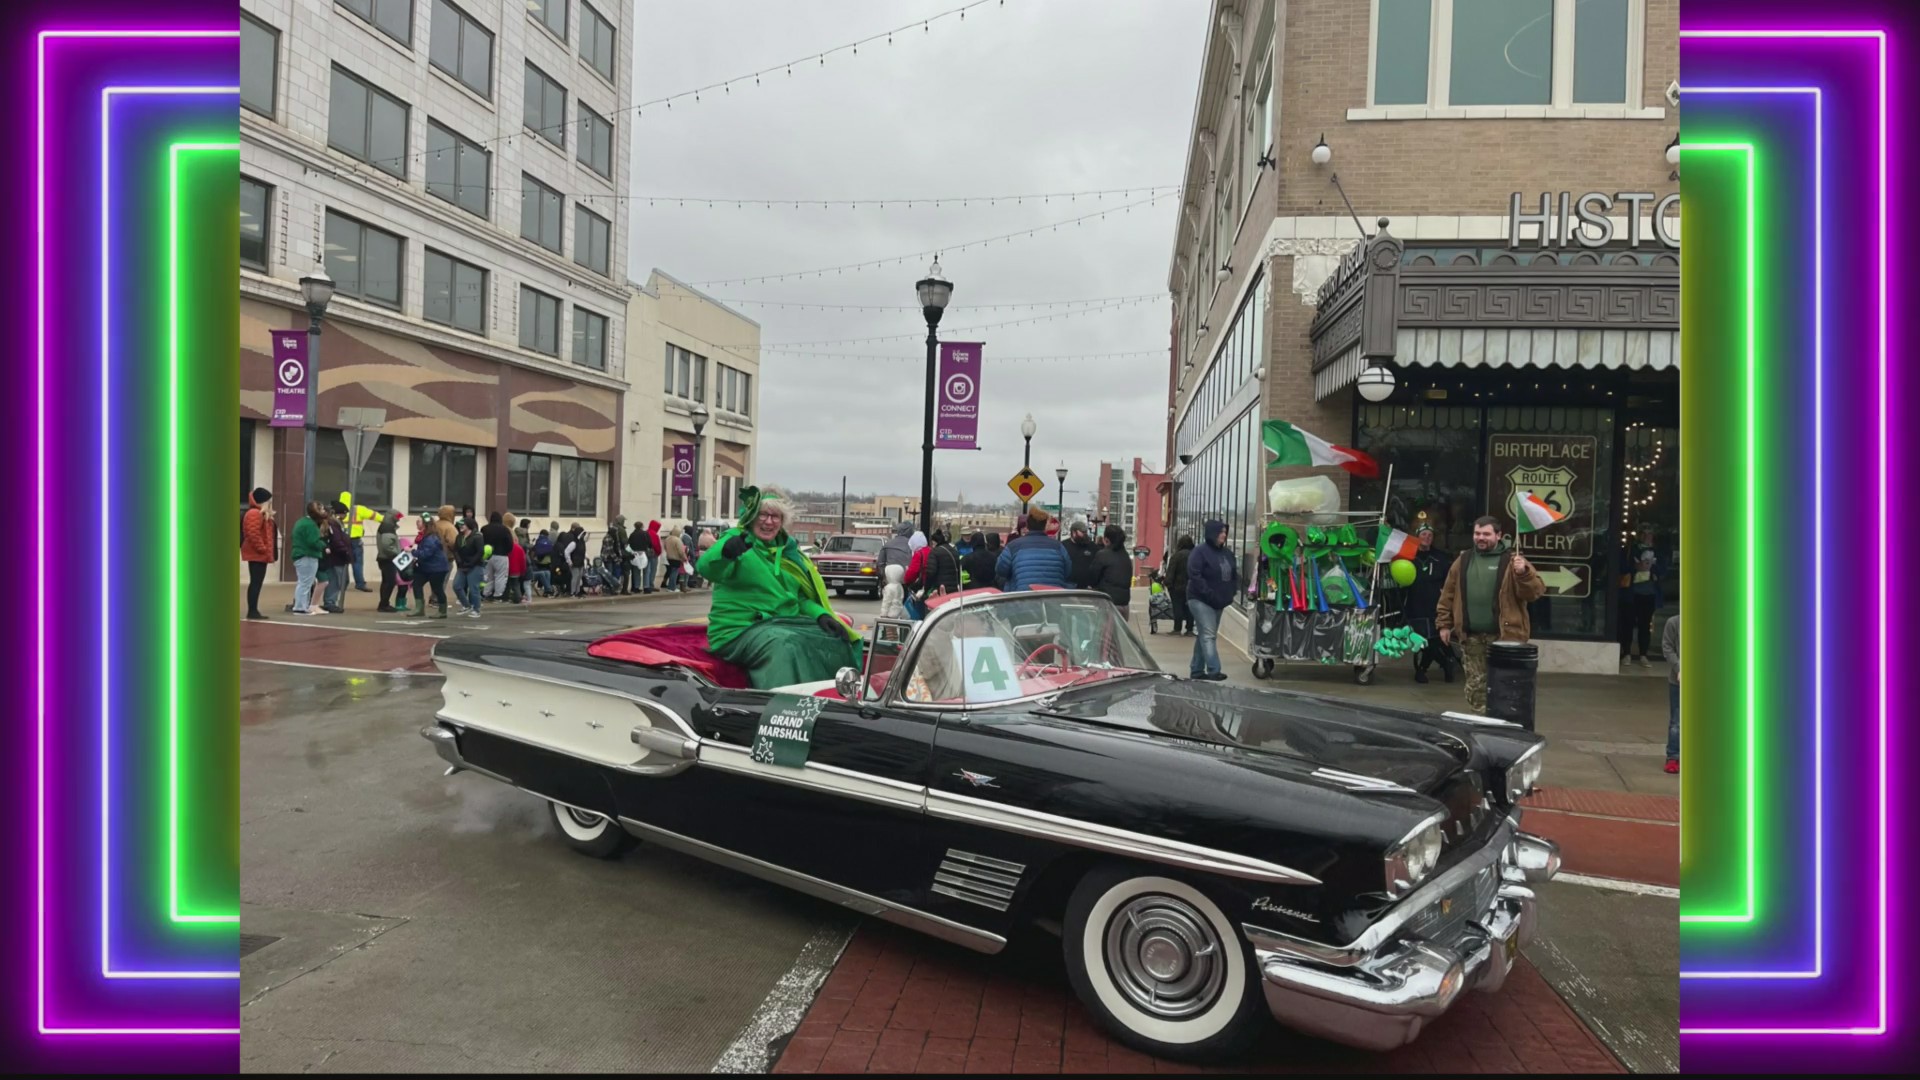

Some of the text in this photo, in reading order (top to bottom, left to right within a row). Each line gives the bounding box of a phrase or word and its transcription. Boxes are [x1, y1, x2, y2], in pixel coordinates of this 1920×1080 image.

[1509, 192, 1680, 249] HISTO
[277, 387, 306, 395] THEATRE
[941, 404, 976, 412] CONNECT
[1494, 442, 1590, 459] BIRTHPLACE
[1522, 472, 1560, 485] ROUTE
[971, 646, 1010, 691] 4
[770, 714, 804, 728] GRAND
[757, 724, 810, 742] MARSHALL
